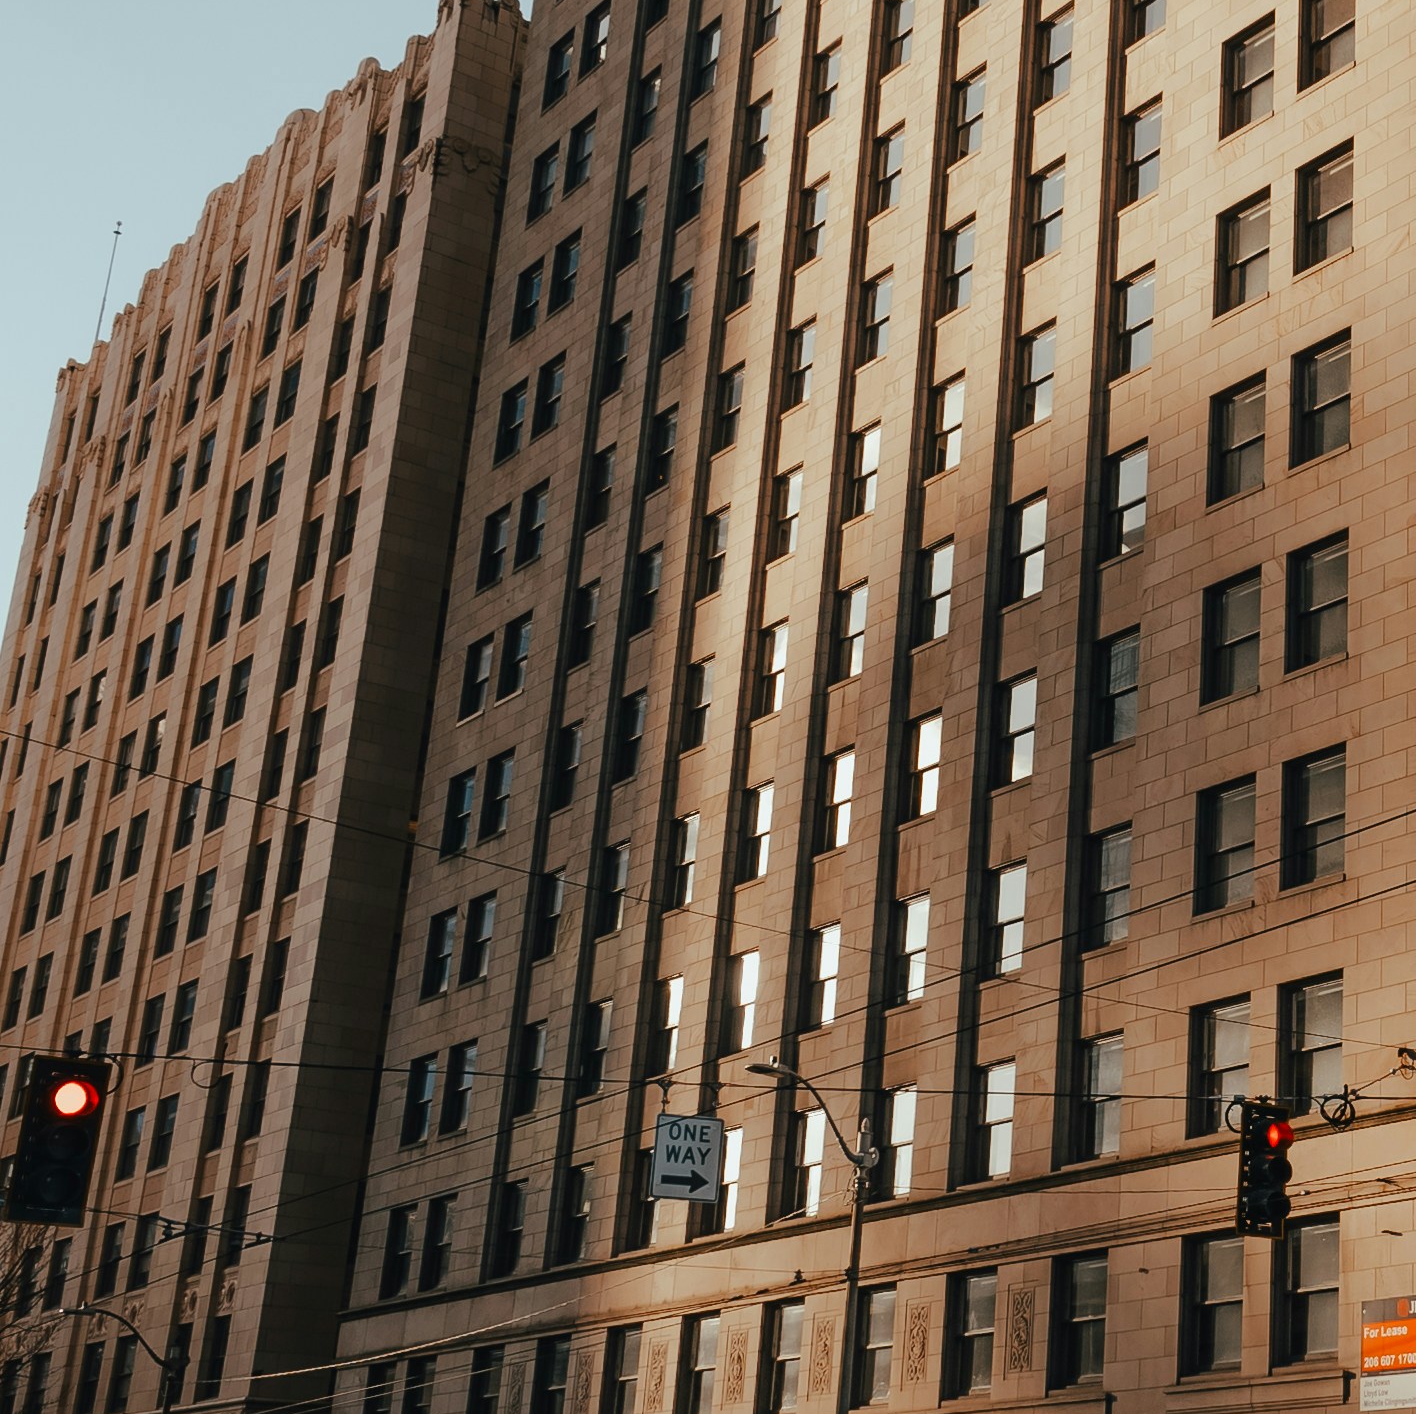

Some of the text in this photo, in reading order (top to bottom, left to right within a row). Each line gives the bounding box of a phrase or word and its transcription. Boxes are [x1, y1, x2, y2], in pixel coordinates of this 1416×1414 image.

[669, 1123, 710, 1143] ONE
[666, 1144, 711, 1165] WAY
[1364, 1326, 1408, 1339] For Lease
[1364, 1357, 1379, 1368] 206
[1381, 1355, 1395, 1366] 607
